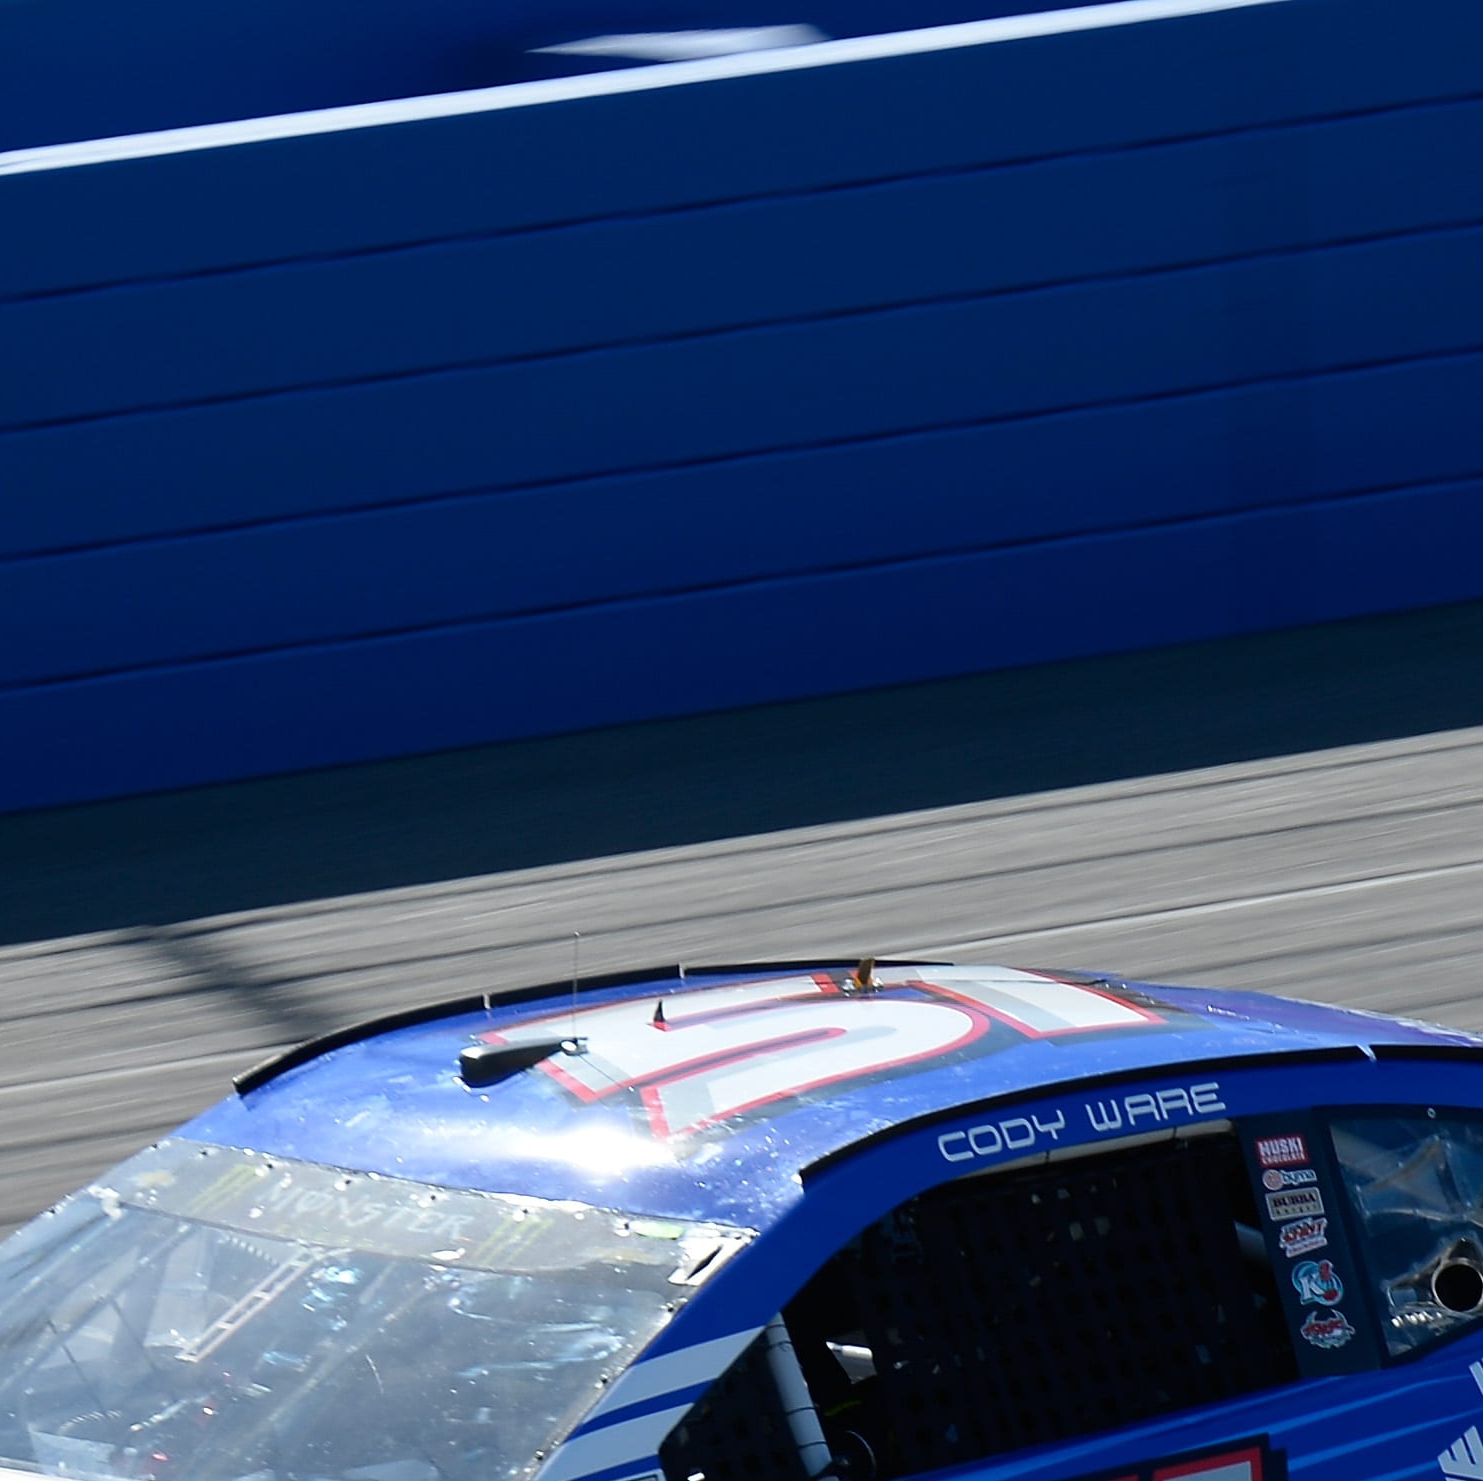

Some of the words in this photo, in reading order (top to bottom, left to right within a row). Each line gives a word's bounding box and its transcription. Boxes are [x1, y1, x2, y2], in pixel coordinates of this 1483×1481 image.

[479, 964, 1169, 1138] 51
[937, 1109, 1066, 1163] CODY
[1084, 1081, 1227, 1133] WARE
